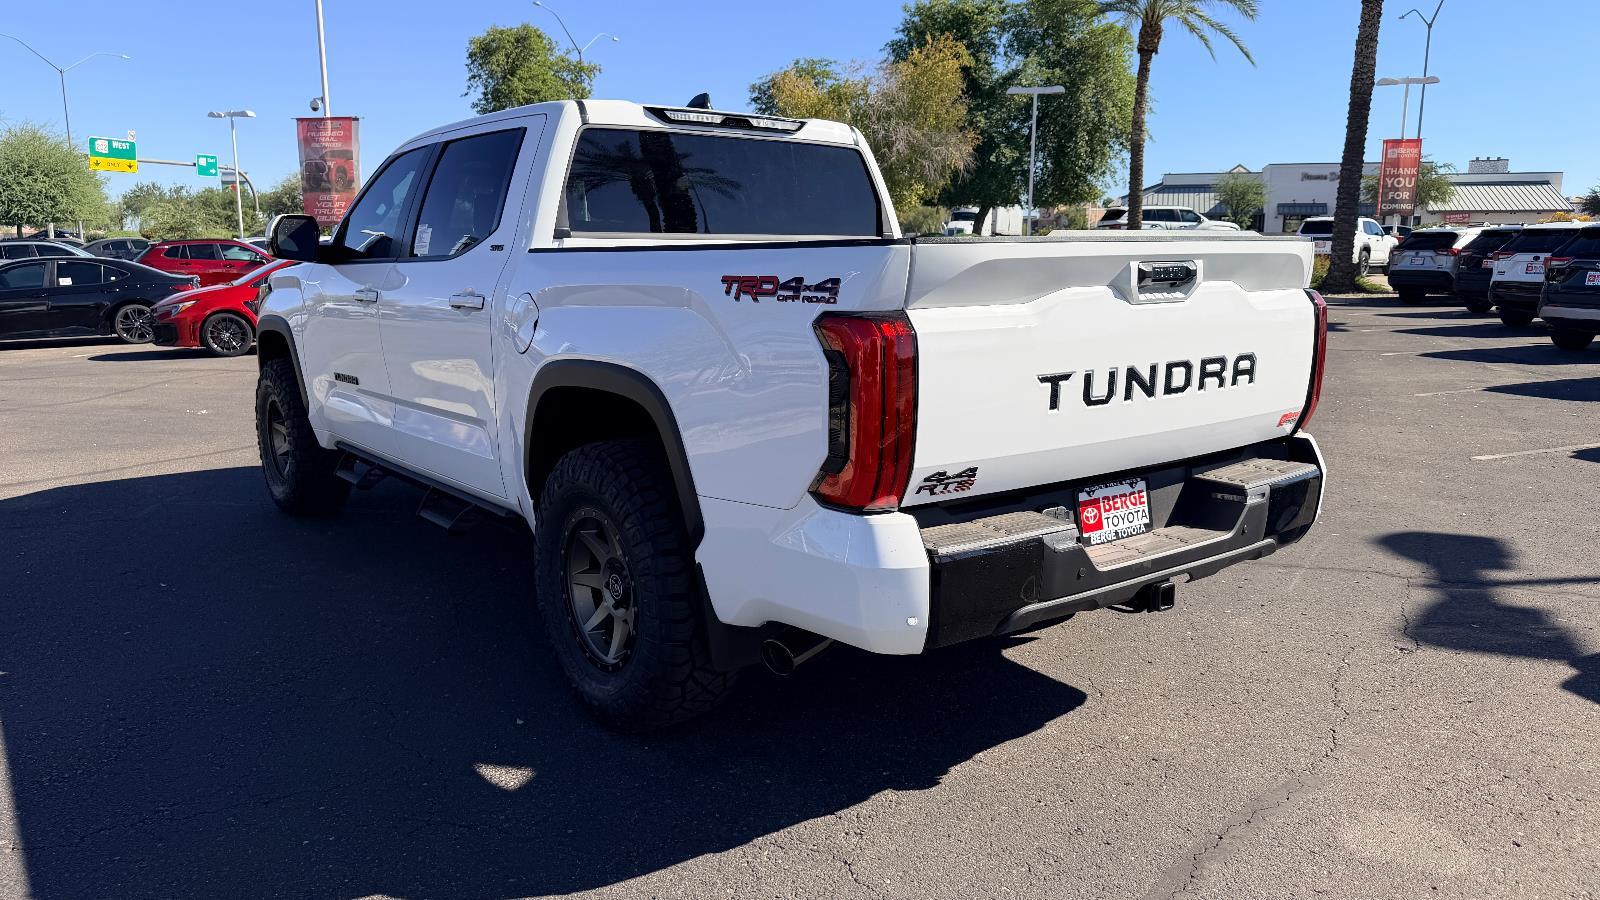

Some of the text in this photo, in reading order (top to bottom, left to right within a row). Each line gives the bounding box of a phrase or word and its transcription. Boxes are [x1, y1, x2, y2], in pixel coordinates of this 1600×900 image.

[112, 140, 130, 150] WEST
[1385, 167, 1418, 175] THANK
[1385, 177, 1415, 188] YOU
[1388, 191, 1410, 200] FOR
[720, 275, 779, 303] TRD
[776, 294, 838, 305] OFF ROAD
[1036, 351, 1258, 412] TUNDRA
[1101, 489, 1146, 514] BERGE
[1104, 508, 1149, 530] TOYOTA
[1090, 523, 1147, 546] BERGE TOYOTA
